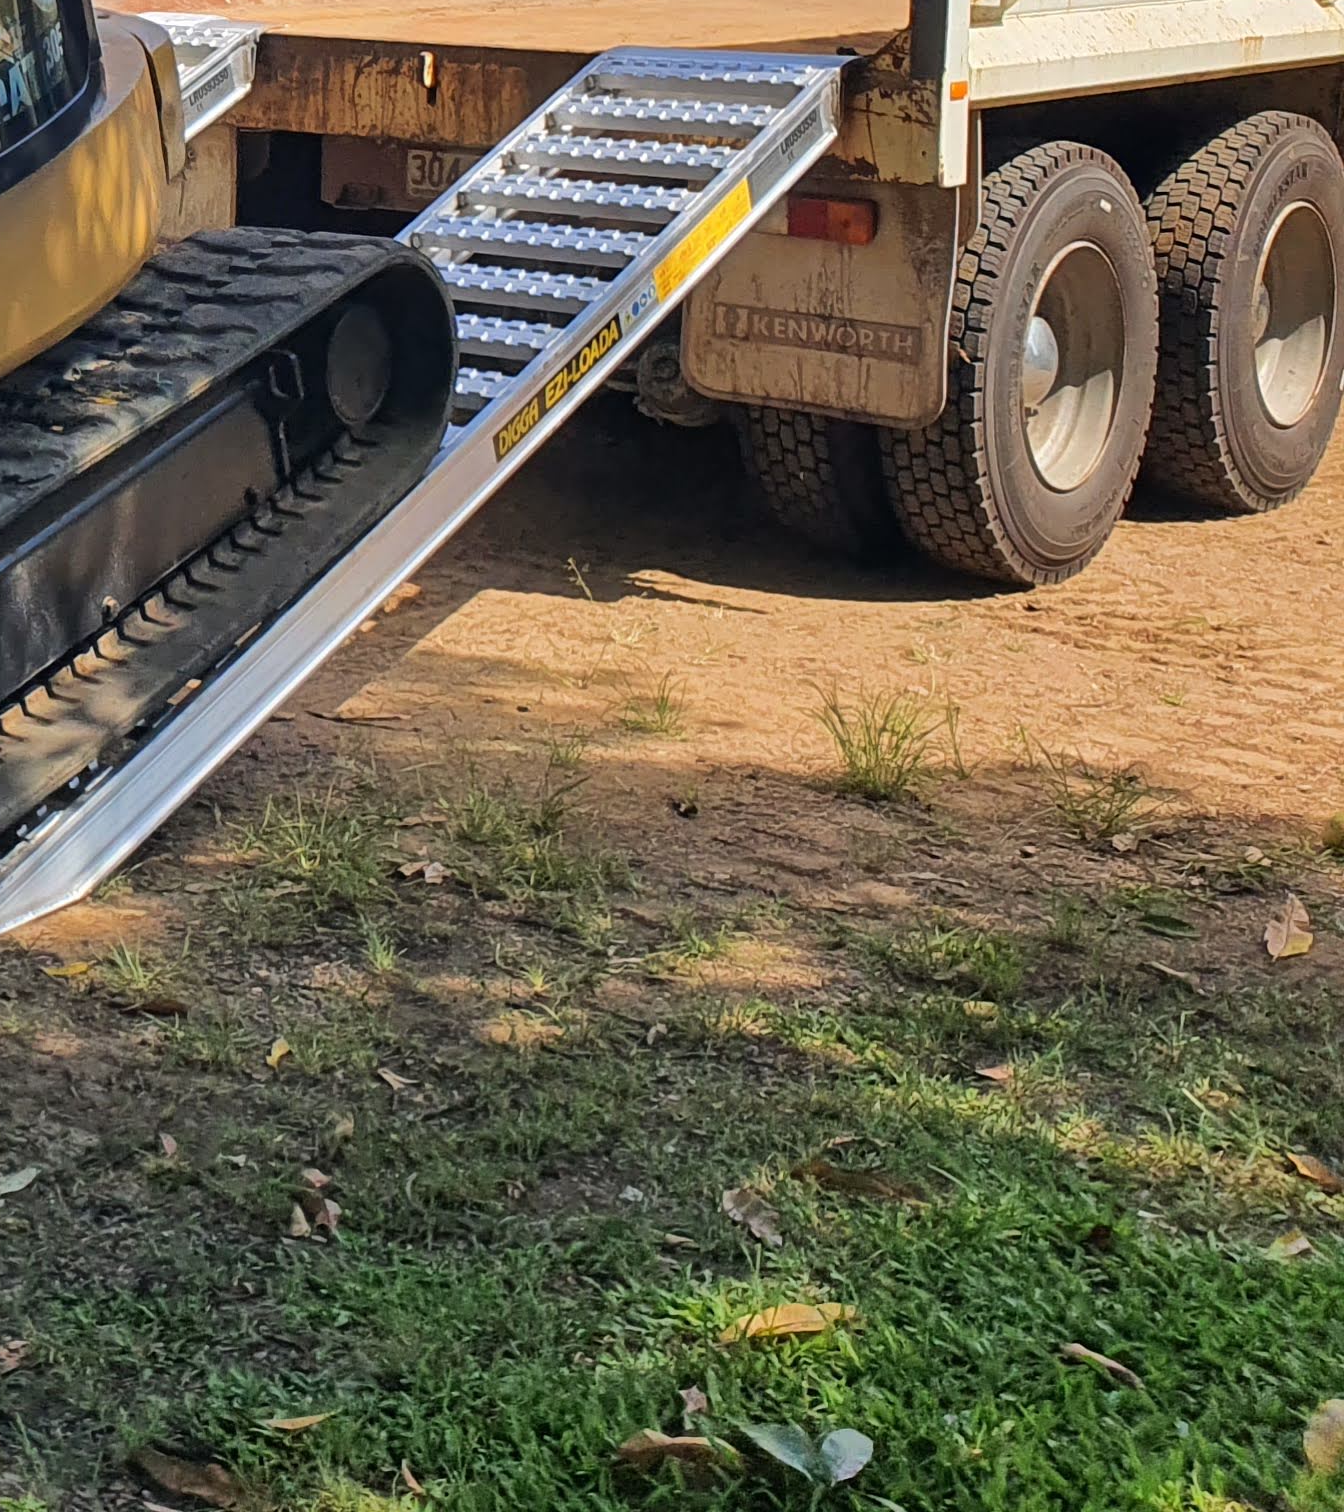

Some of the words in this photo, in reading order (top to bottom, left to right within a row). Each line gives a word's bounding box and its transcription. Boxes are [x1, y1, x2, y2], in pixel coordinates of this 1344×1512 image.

[752, 313, 913, 356] KENWORTH
[498, 397, 540, 456] DIGGA
[544, 319, 619, 410] EZI-LOADA
